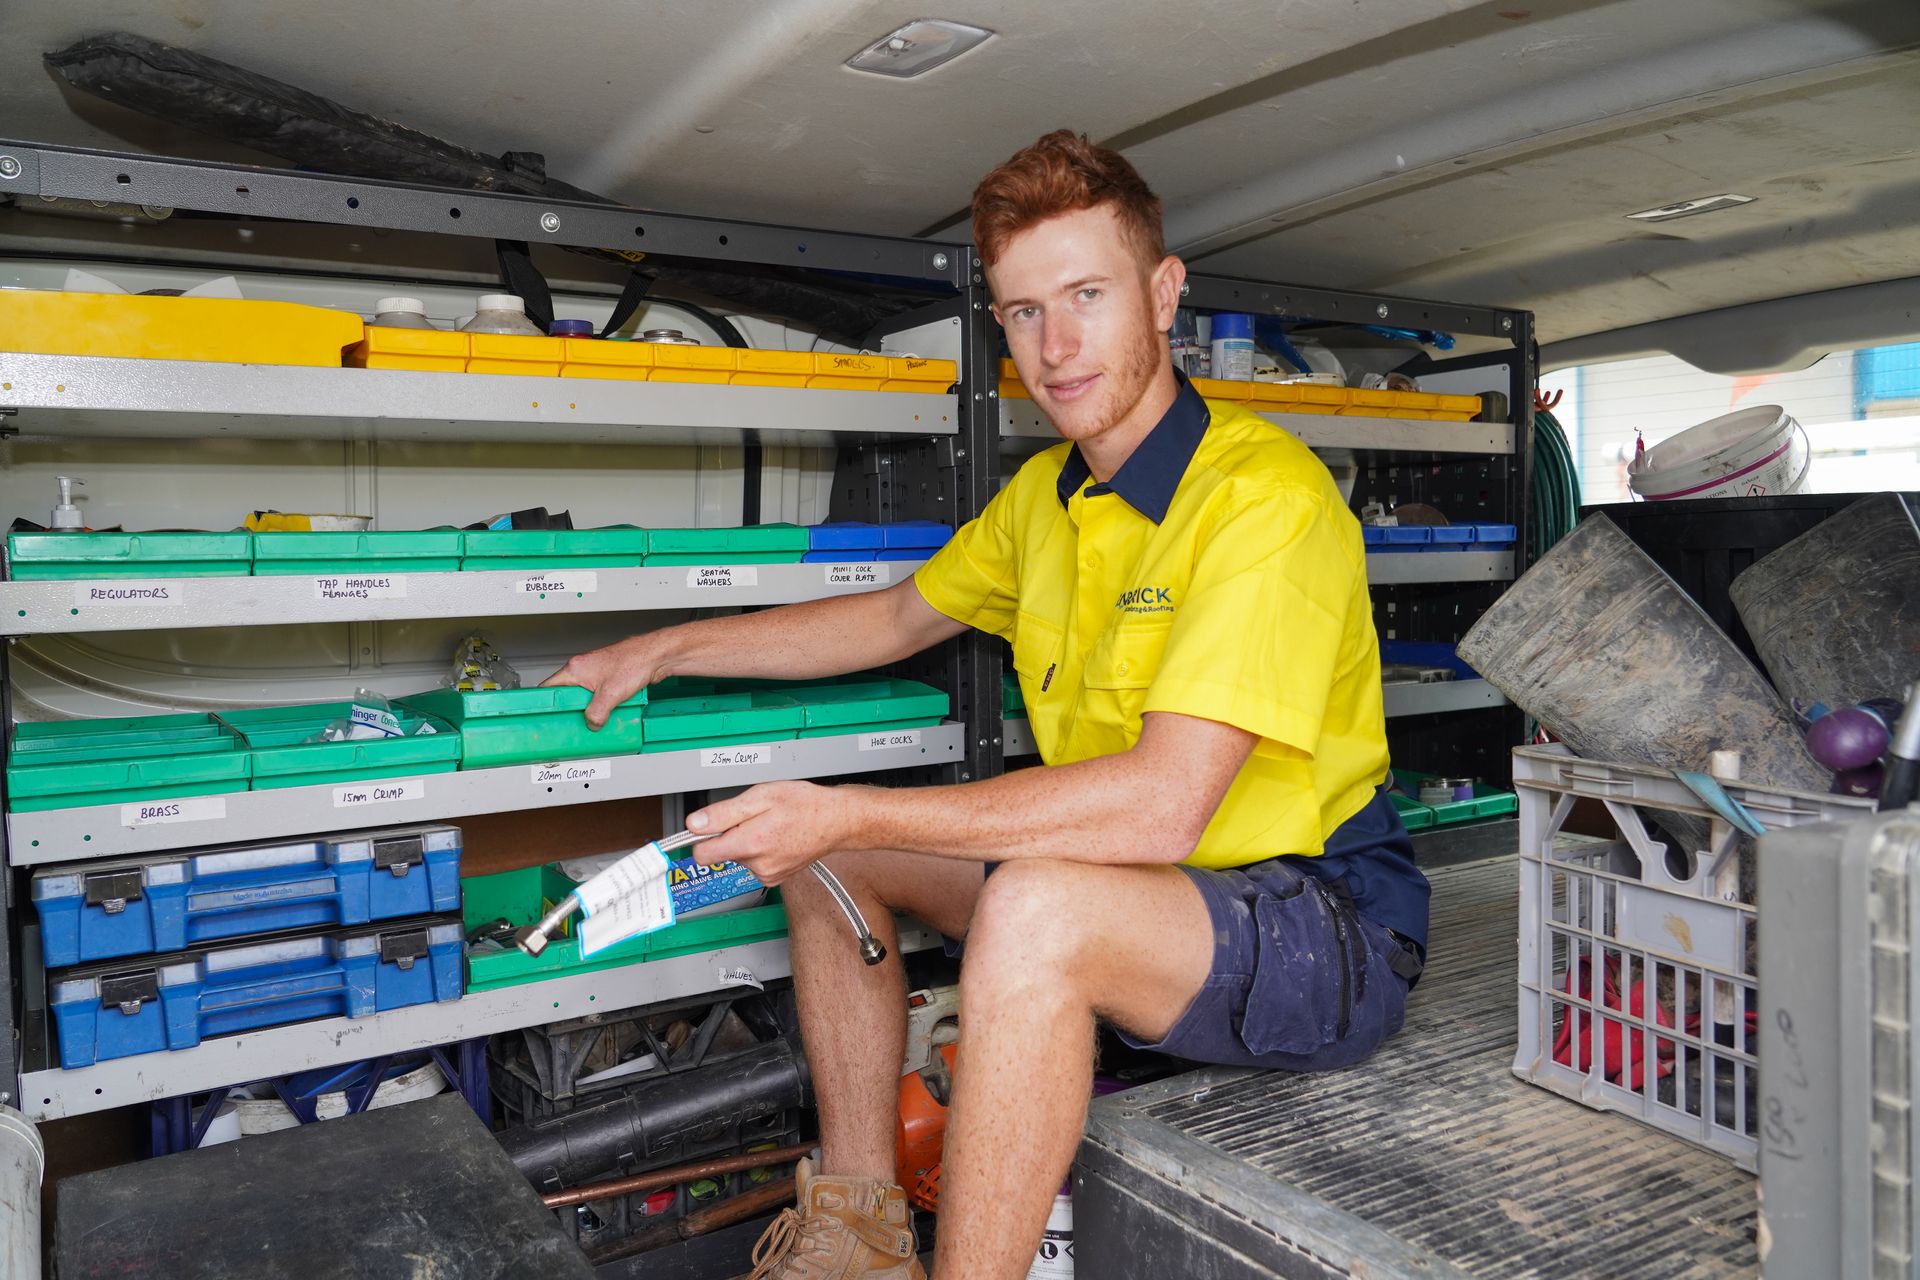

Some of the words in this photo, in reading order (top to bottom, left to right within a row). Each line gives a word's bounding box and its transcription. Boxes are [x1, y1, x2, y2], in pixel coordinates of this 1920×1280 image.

[700, 568, 731, 578] SEATING
[855, 565, 872, 573] COCK
[696, 578, 733, 587] WASHERS
[855, 573, 877, 582] PLATE
[317, 579, 338, 589] TAP
[345, 578, 391, 589] HANDLES
[525, 582, 565, 592] RUBBERS
[90, 587, 169, 600] REGULATORS
[322, 589, 369, 599] FLANGES
[871, 737, 887, 747] HOSE
[890, 735, 913, 745] COCKS
[537, 770, 562, 782] 20mm
[566, 767, 596, 779] CRIMP
[343, 792, 367, 803] 15mm
[373, 787, 404, 800] CRIMP
[141, 804, 180, 819] BRASS
[690, 875, 713, 887] VALVE
